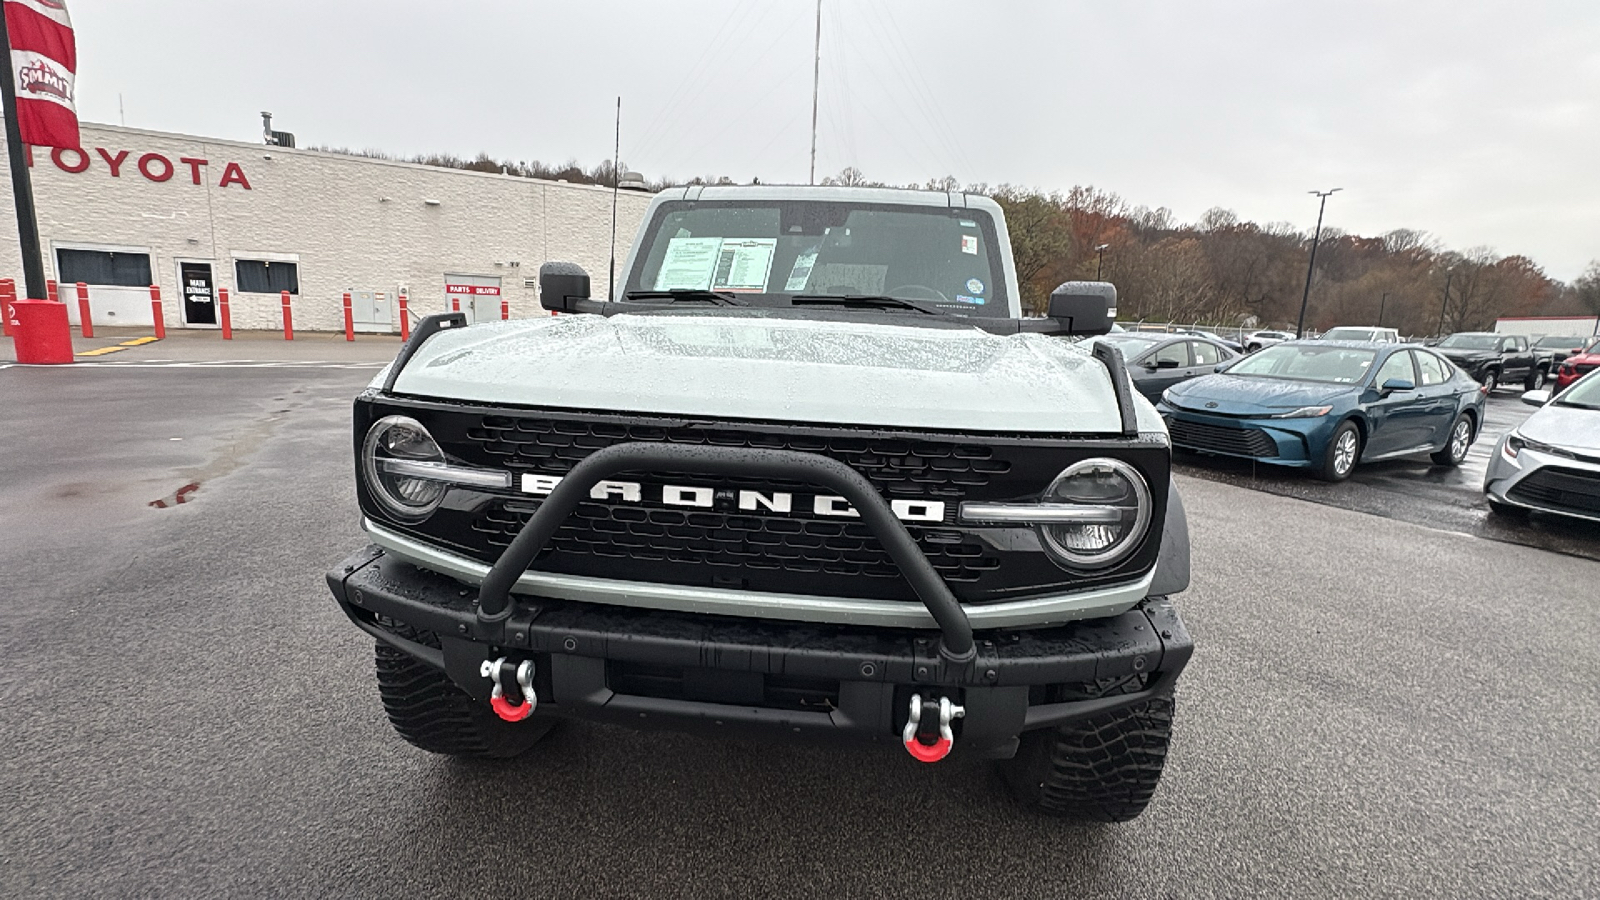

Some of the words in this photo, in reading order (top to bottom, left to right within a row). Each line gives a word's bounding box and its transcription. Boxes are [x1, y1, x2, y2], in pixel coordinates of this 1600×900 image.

[25, 145, 252, 190] OYOTA
[186, 287, 211, 295] ENTRANCE
[189, 279, 206, 287] MAIN
[521, 473, 945, 522] BRONCO
